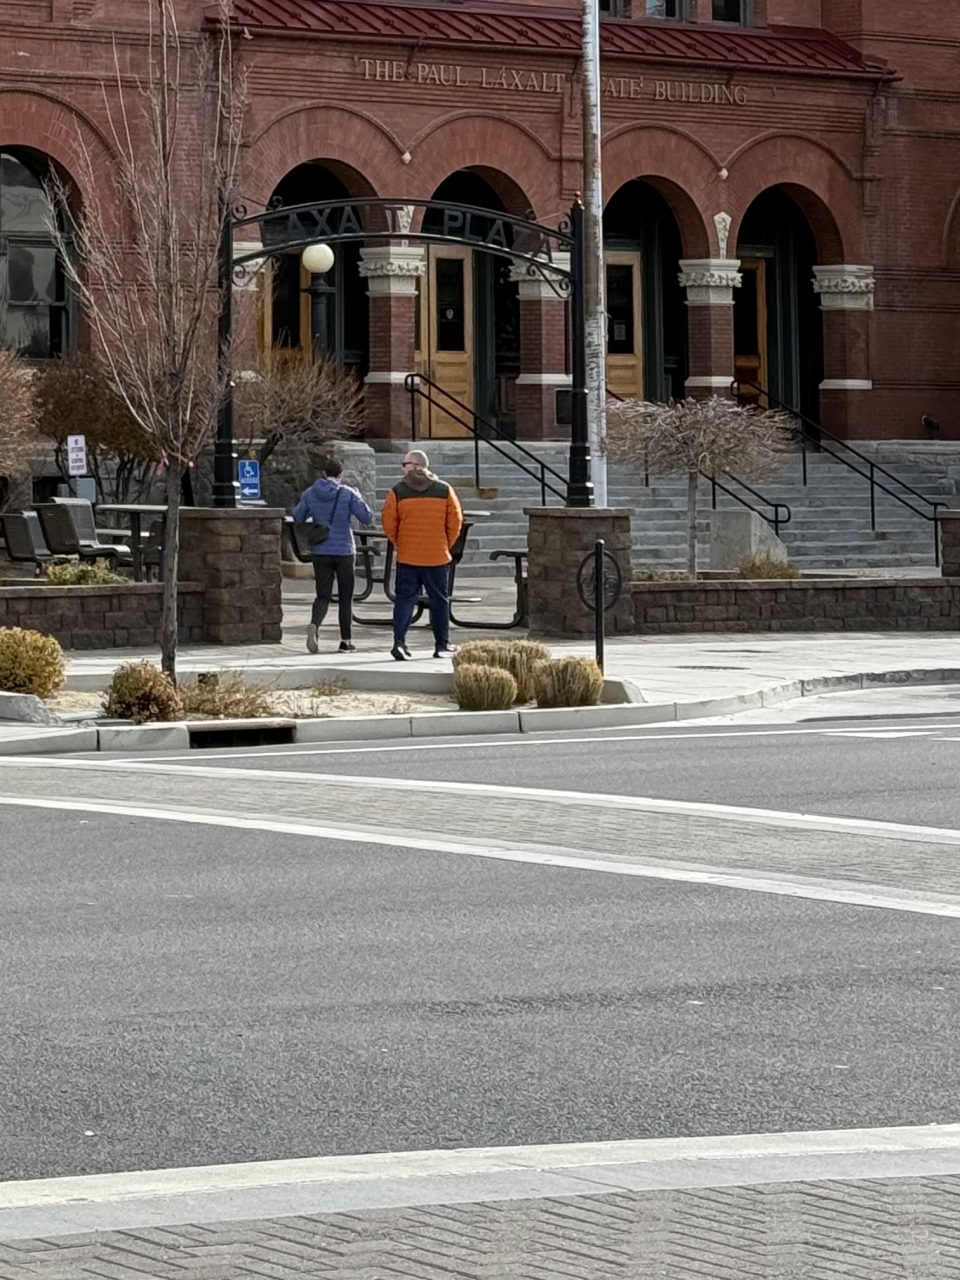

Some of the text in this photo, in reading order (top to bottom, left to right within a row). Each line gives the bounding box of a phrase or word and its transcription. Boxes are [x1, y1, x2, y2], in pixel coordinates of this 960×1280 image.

[360, 58, 748, 105] THE PAUL LAXALT ATE BUILDING
